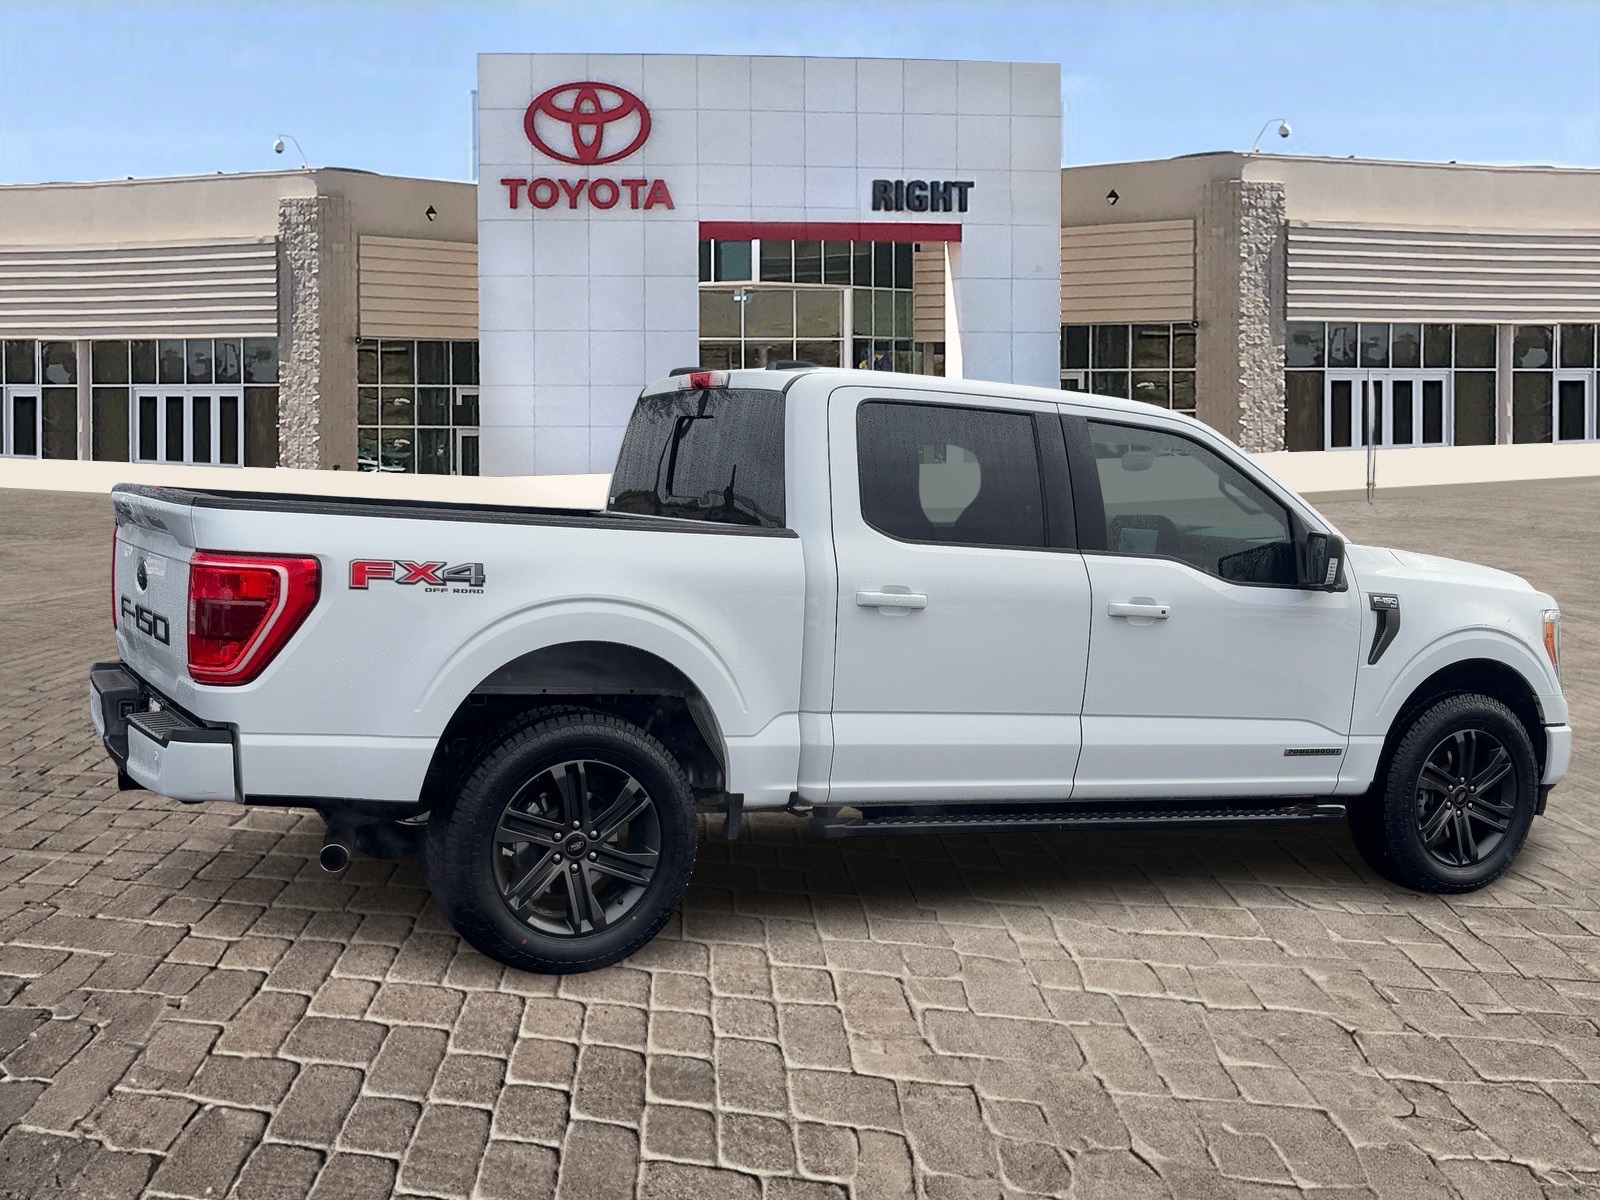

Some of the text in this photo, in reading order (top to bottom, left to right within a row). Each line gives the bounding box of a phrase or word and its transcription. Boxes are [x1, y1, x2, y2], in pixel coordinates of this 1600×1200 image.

[500, 177, 676, 210] TOYOTA
[871, 179, 975, 213] RIGHT
[348, 558, 486, 590] FX4
[121, 593, 171, 647] F-150
